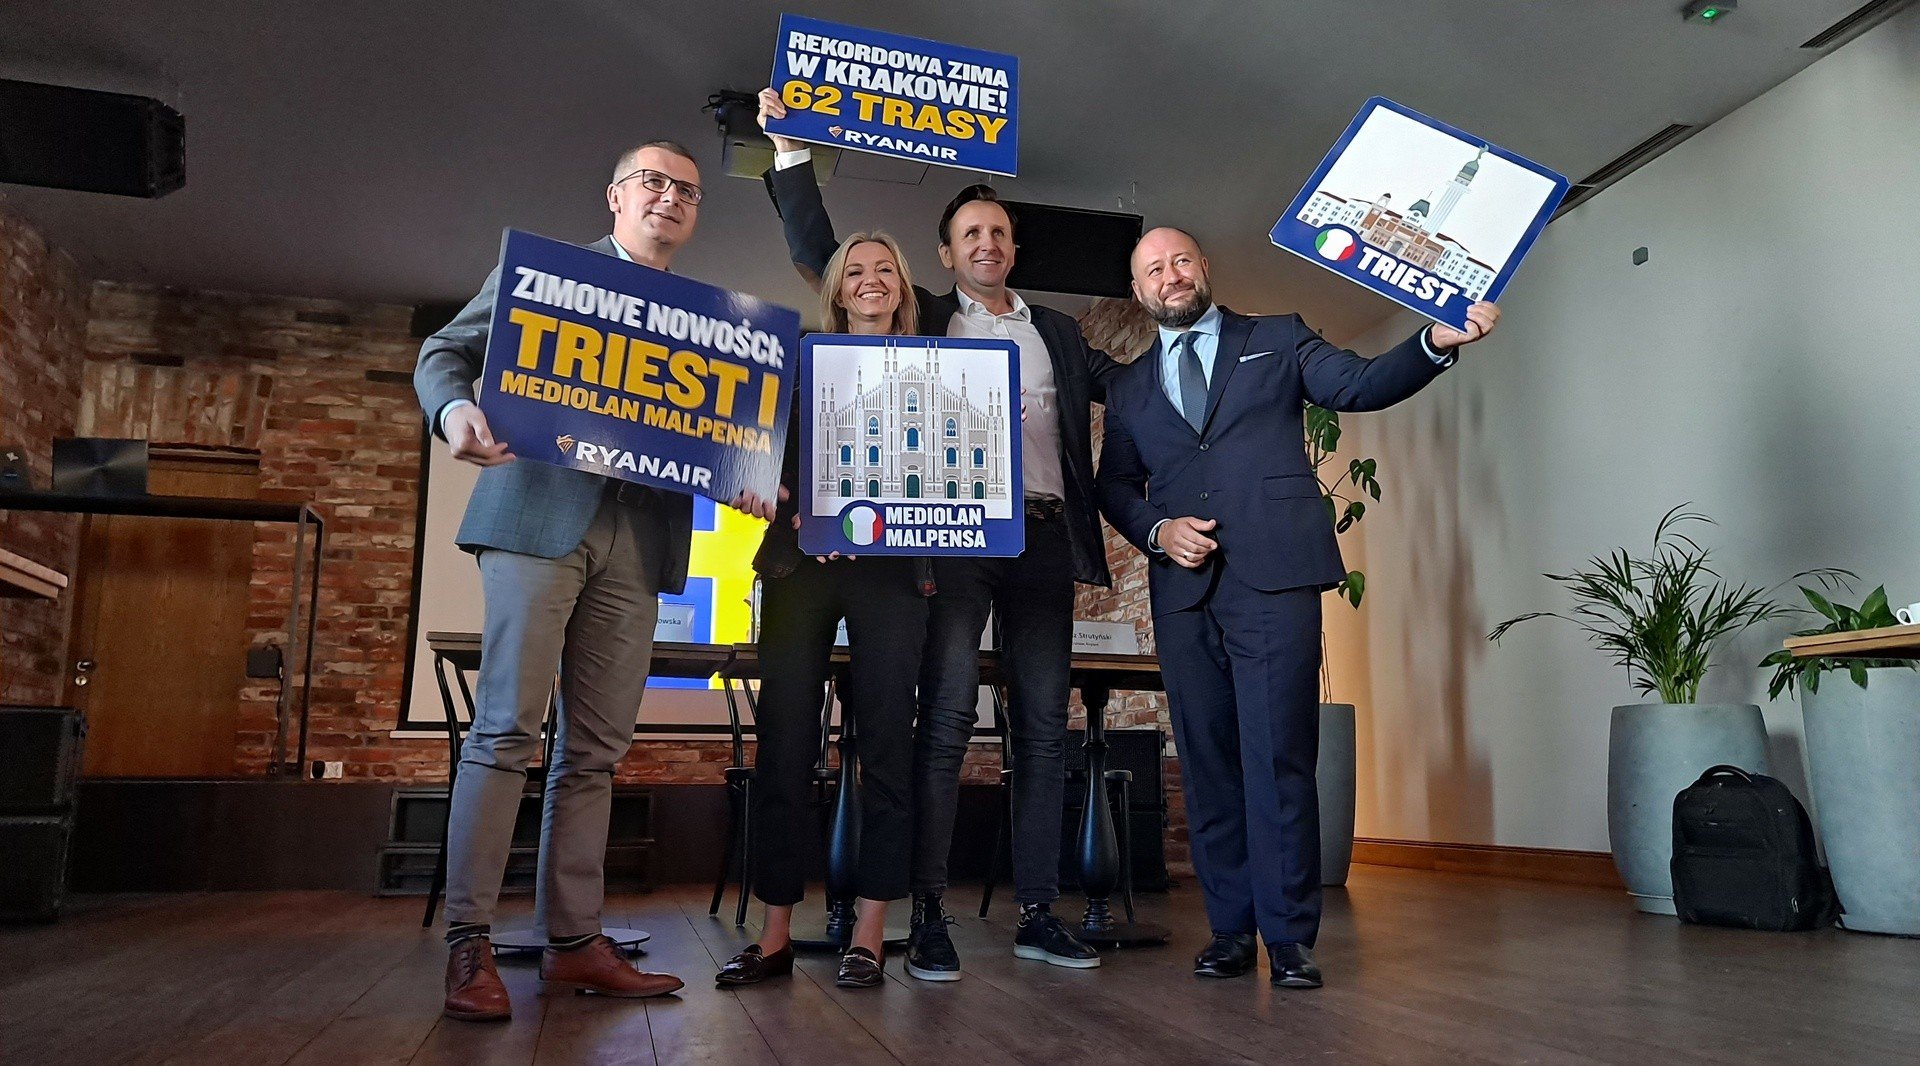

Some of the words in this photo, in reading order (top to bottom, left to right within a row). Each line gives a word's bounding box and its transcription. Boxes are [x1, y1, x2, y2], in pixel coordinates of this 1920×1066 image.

[786, 50, 821, 78] W
[825, 61, 1008, 114] KRAKOWIE!
[788, 31, 943, 76] REKORDOWA
[946, 60, 1009, 88] ZIMA
[782, 80, 842, 116] 62
[852, 91, 1008, 144] TRASY
[844, 129, 958, 161] RYANAIR
[1357, 246, 1459, 308] TRIEST
[510, 266, 645, 330] ZIMOWE
[646, 301, 785, 370] NOWOŚCI:
[509, 307, 750, 419] TRIEST
[757, 372, 781, 430] I
[500, 369, 639, 422] MEDIOLAN
[643, 403, 773, 456] MALPENSA
[575, 441, 712, 489] RYANAIR
[885, 506, 982, 526] MEDIOLAN
[885, 529, 986, 548] MALPENSA
